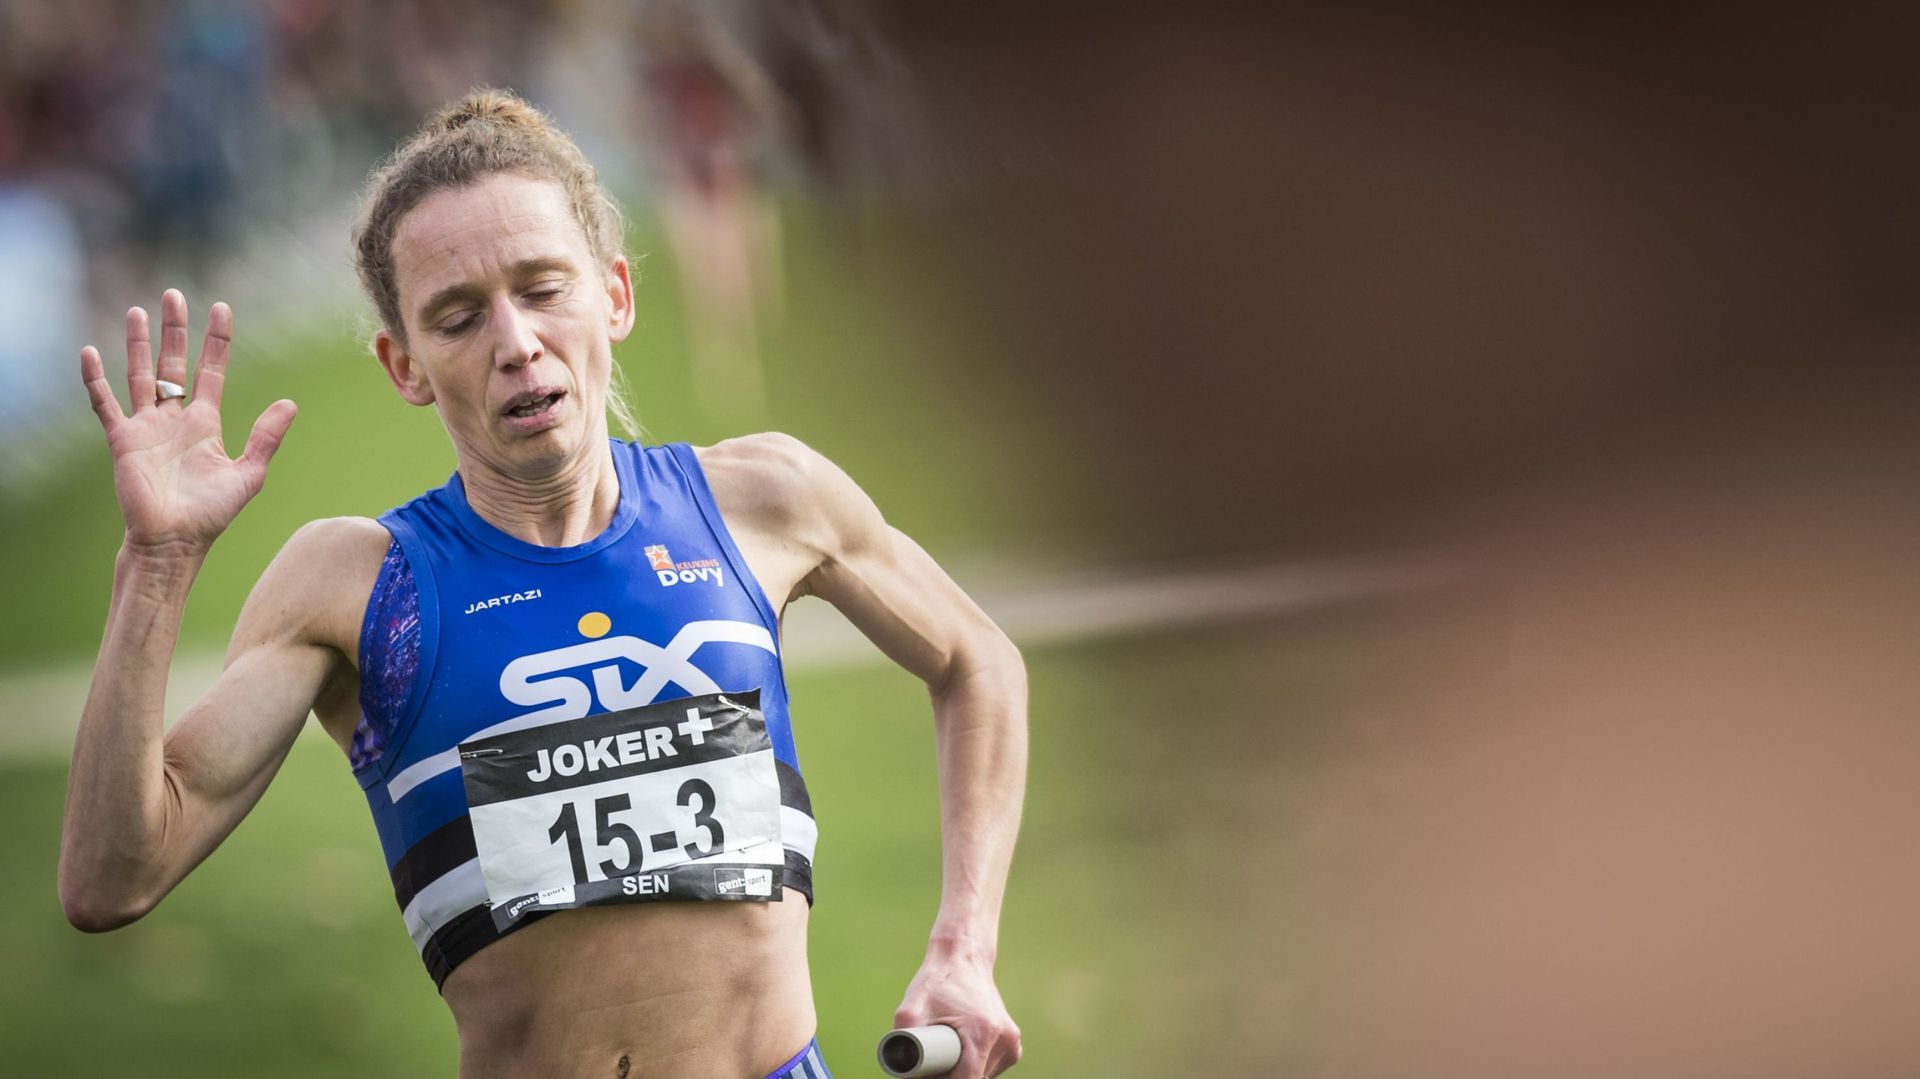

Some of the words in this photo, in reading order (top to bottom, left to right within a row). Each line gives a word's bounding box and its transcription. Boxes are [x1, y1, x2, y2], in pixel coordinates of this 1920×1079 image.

[676, 559, 719, 570] KEUKENS
[465, 589, 542, 614] JARTAZI
[548, 778, 724, 885] 15-3
[622, 875, 670, 895] SEN
